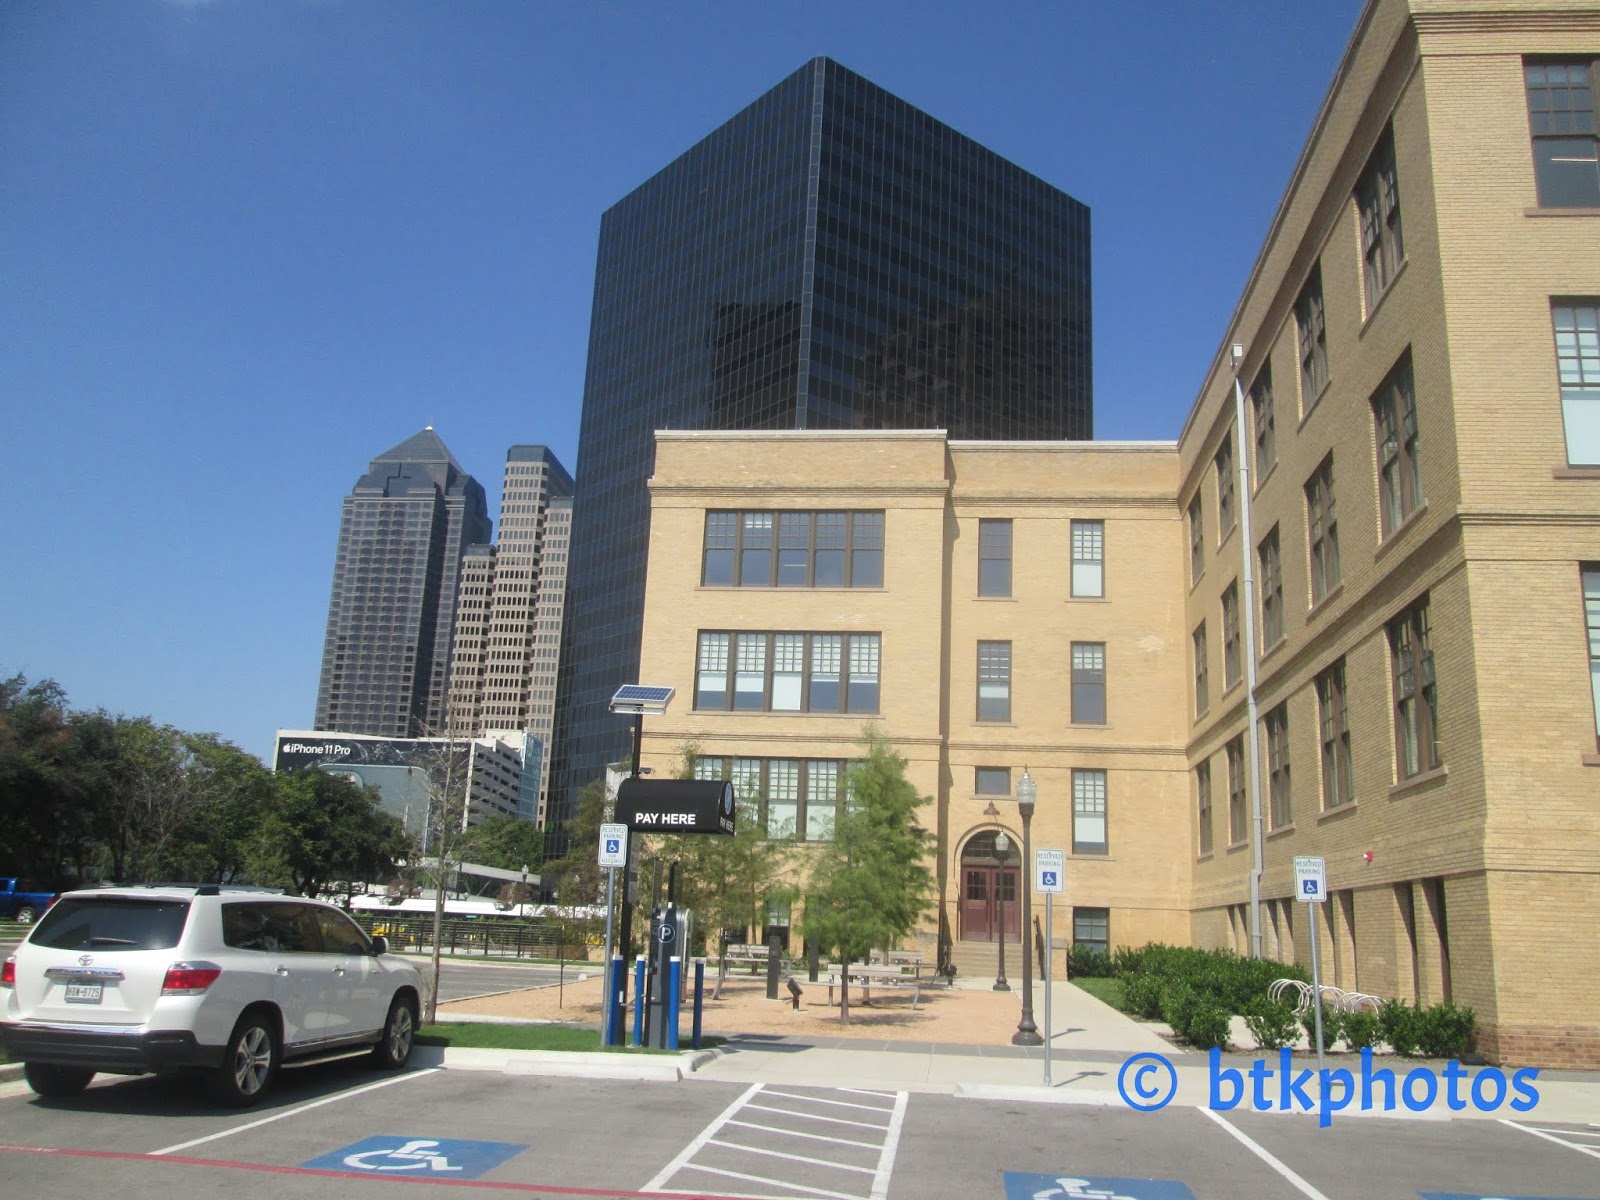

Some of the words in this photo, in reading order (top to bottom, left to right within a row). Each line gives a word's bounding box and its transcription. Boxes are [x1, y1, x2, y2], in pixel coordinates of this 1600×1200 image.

[290, 743, 324, 754] iPhone
[324, 744, 333, 755] 11
[334, 744, 351, 755] Pro
[635, 812, 659, 825] PAY
[661, 813, 696, 825] HERE
[602, 826, 626, 834] RESERVED
[603, 832, 625, 840] PARKING
[1037, 852, 1063, 860] RESERVED
[1296, 860, 1322, 868] RESERVED
[661, 926, 672, 940] P
